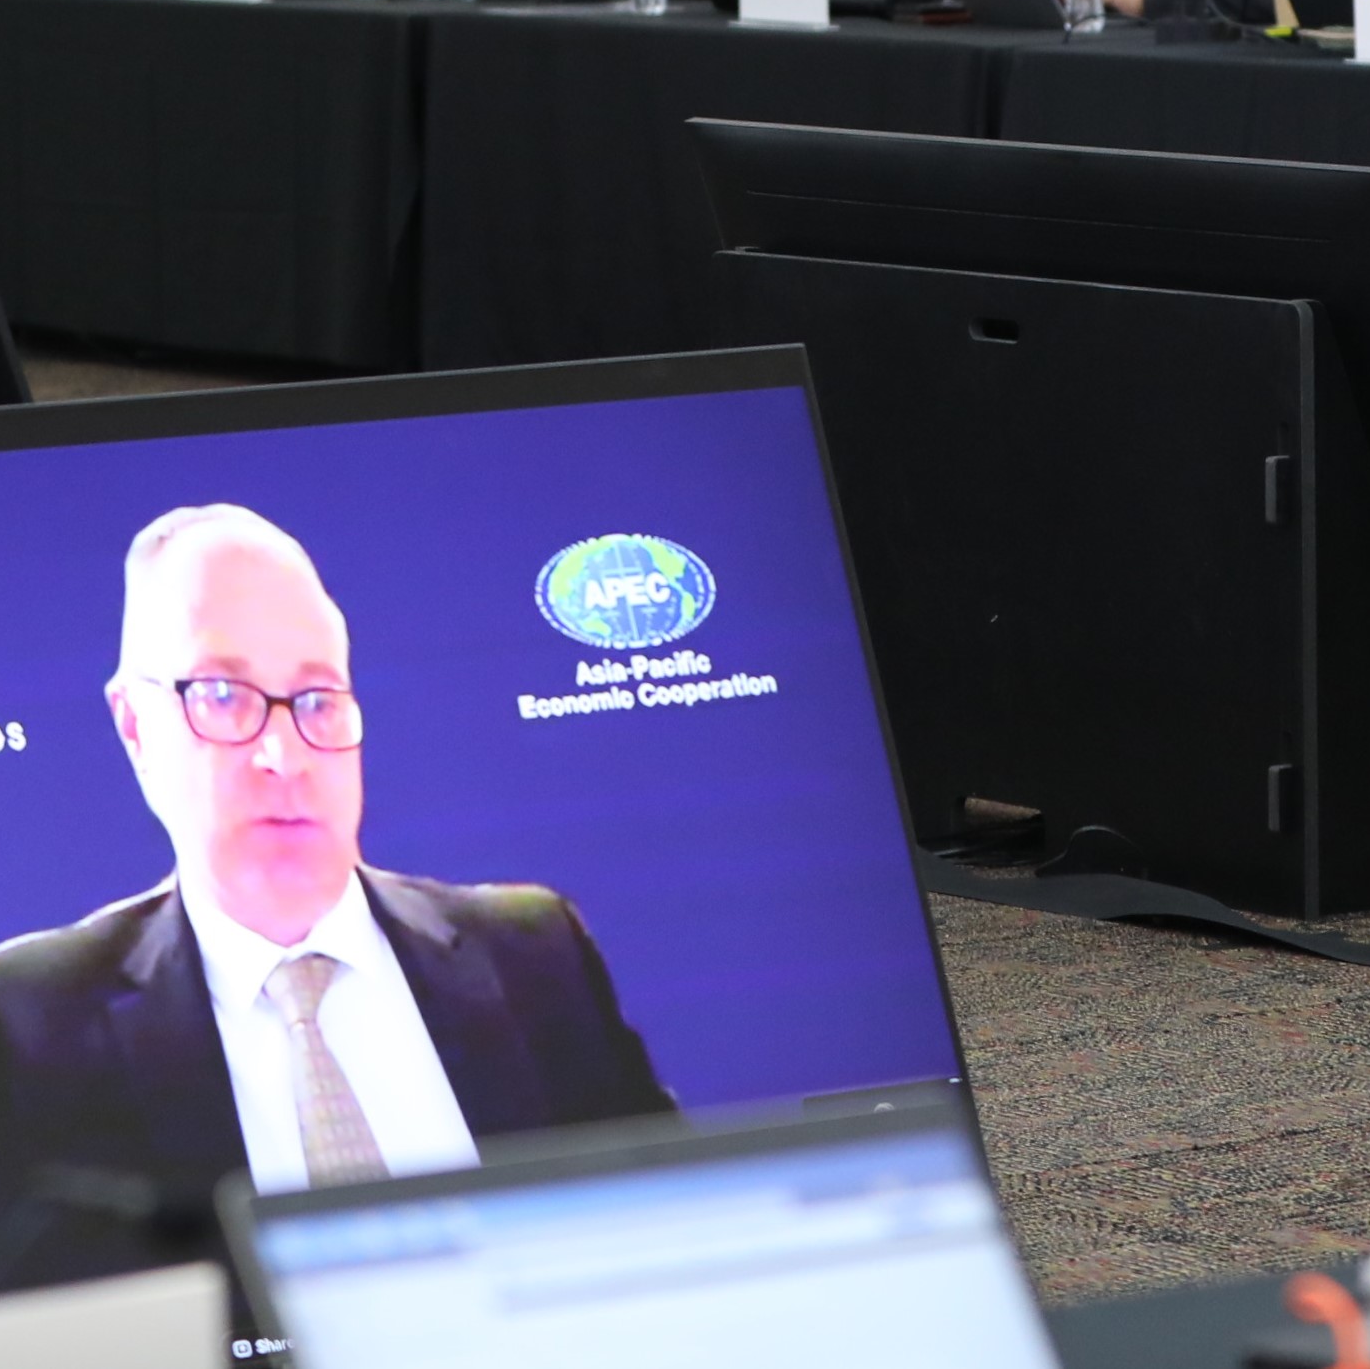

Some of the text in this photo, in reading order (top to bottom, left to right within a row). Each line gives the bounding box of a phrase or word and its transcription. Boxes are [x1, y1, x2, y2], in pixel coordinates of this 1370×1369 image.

[583, 572, 671, 610] APEC
[575, 650, 712, 687] Asia-Pacific
[517, 672, 778, 719] Economic Cooperation
